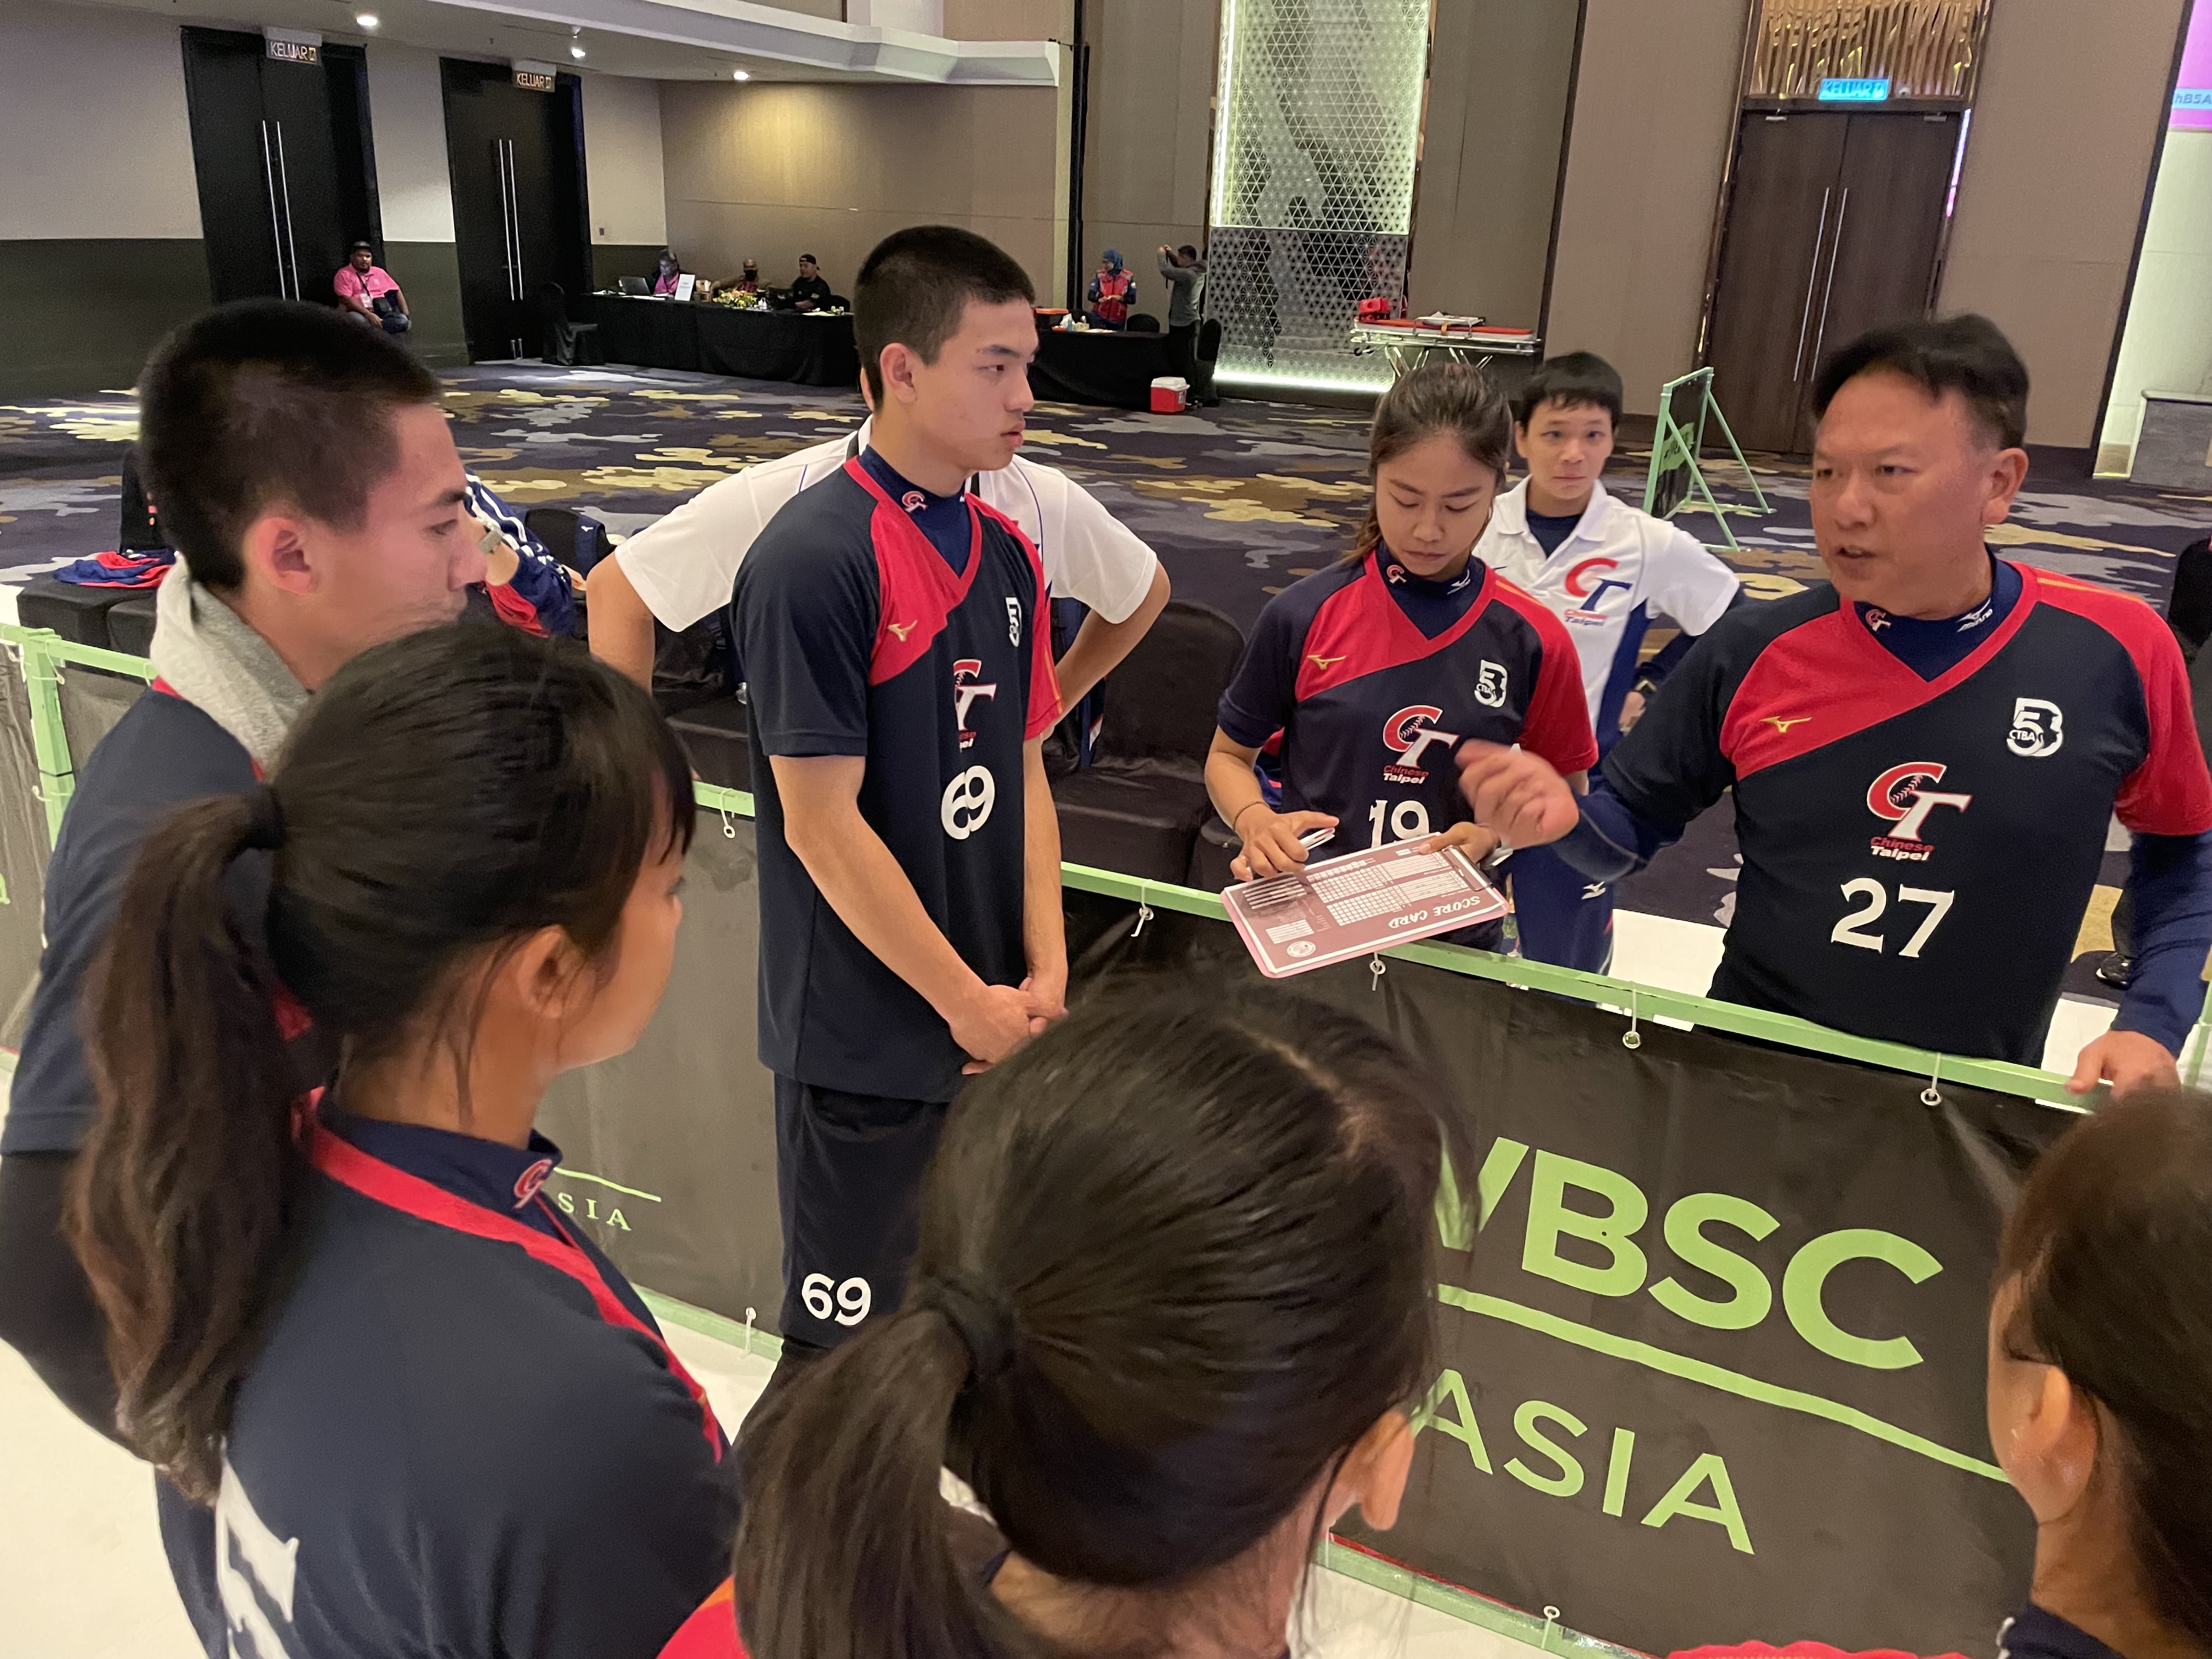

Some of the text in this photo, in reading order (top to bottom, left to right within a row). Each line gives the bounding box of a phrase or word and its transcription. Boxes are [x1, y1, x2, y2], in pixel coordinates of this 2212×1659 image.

[270, 41, 308, 60] KELUAR
[516, 72, 545, 88] KELUAR
[1821, 80, 1873, 98] KELUAR
[1383, 772, 1426, 784] Taipei
[1384, 765, 1429, 777] Chinese
[941, 765, 996, 840] 69
[1369, 800, 1430, 849] 19
[1870, 836, 1934, 853] Chinese
[1870, 845, 1929, 861] Taipei
[1388, 896, 1481, 929] SCORE CARD
[1831, 877, 1955, 958] 27
[558, 1192, 633, 1231] SIA
[802, 1273, 872, 1327] 69
[1411, 1369, 1756, 1555] ASIA
